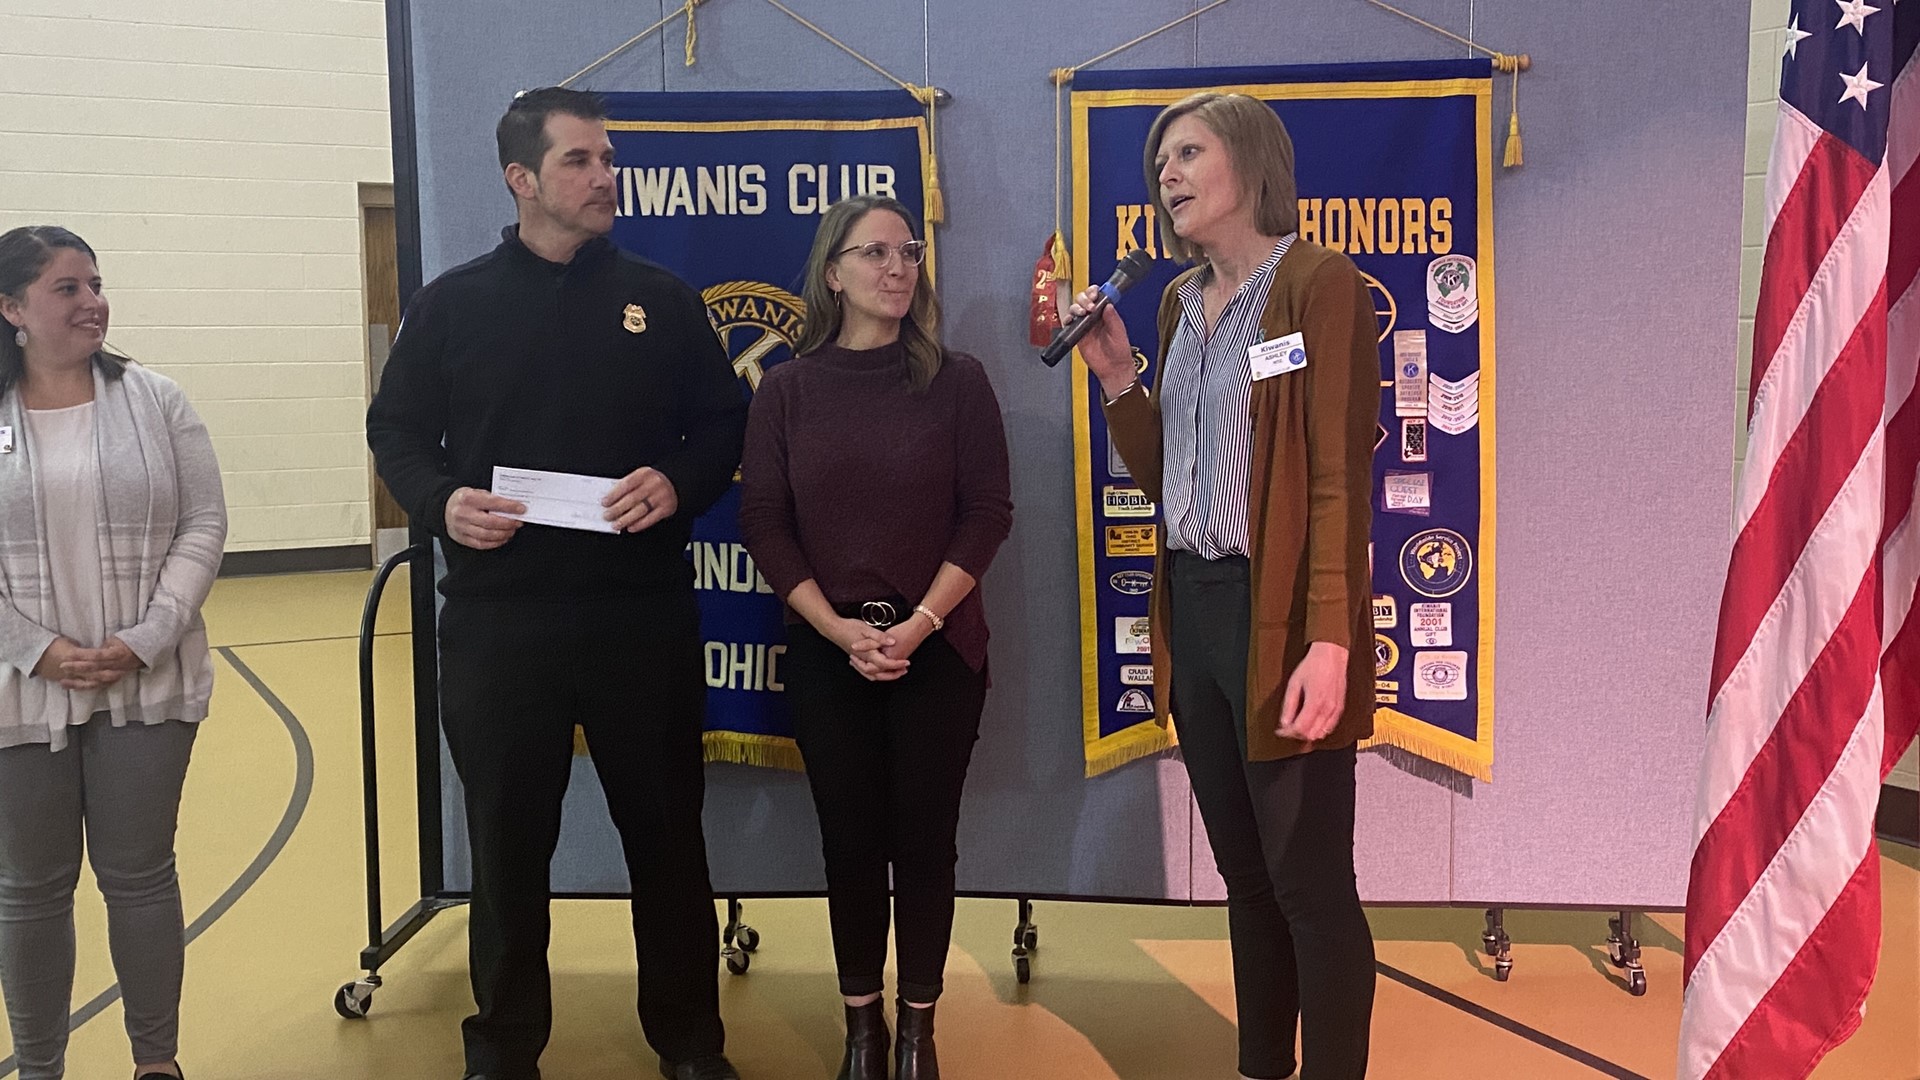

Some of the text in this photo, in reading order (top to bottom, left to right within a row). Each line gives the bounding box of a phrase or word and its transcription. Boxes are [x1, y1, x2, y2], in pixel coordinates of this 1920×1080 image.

[788, 163, 896, 216] CLUB
[1297, 197, 1453, 255] HONORS
[1261, 340, 1291, 352] Kiwanis
[1265, 351, 1287, 361] ASHLEY
[1390, 485, 1418, 495] GUEST
[1107, 495, 1149, 506] HOBY
[1407, 495, 1424, 504] DAY
[1435, 534, 1454, 544] Service
[1420, 618, 1442, 626] 2001
